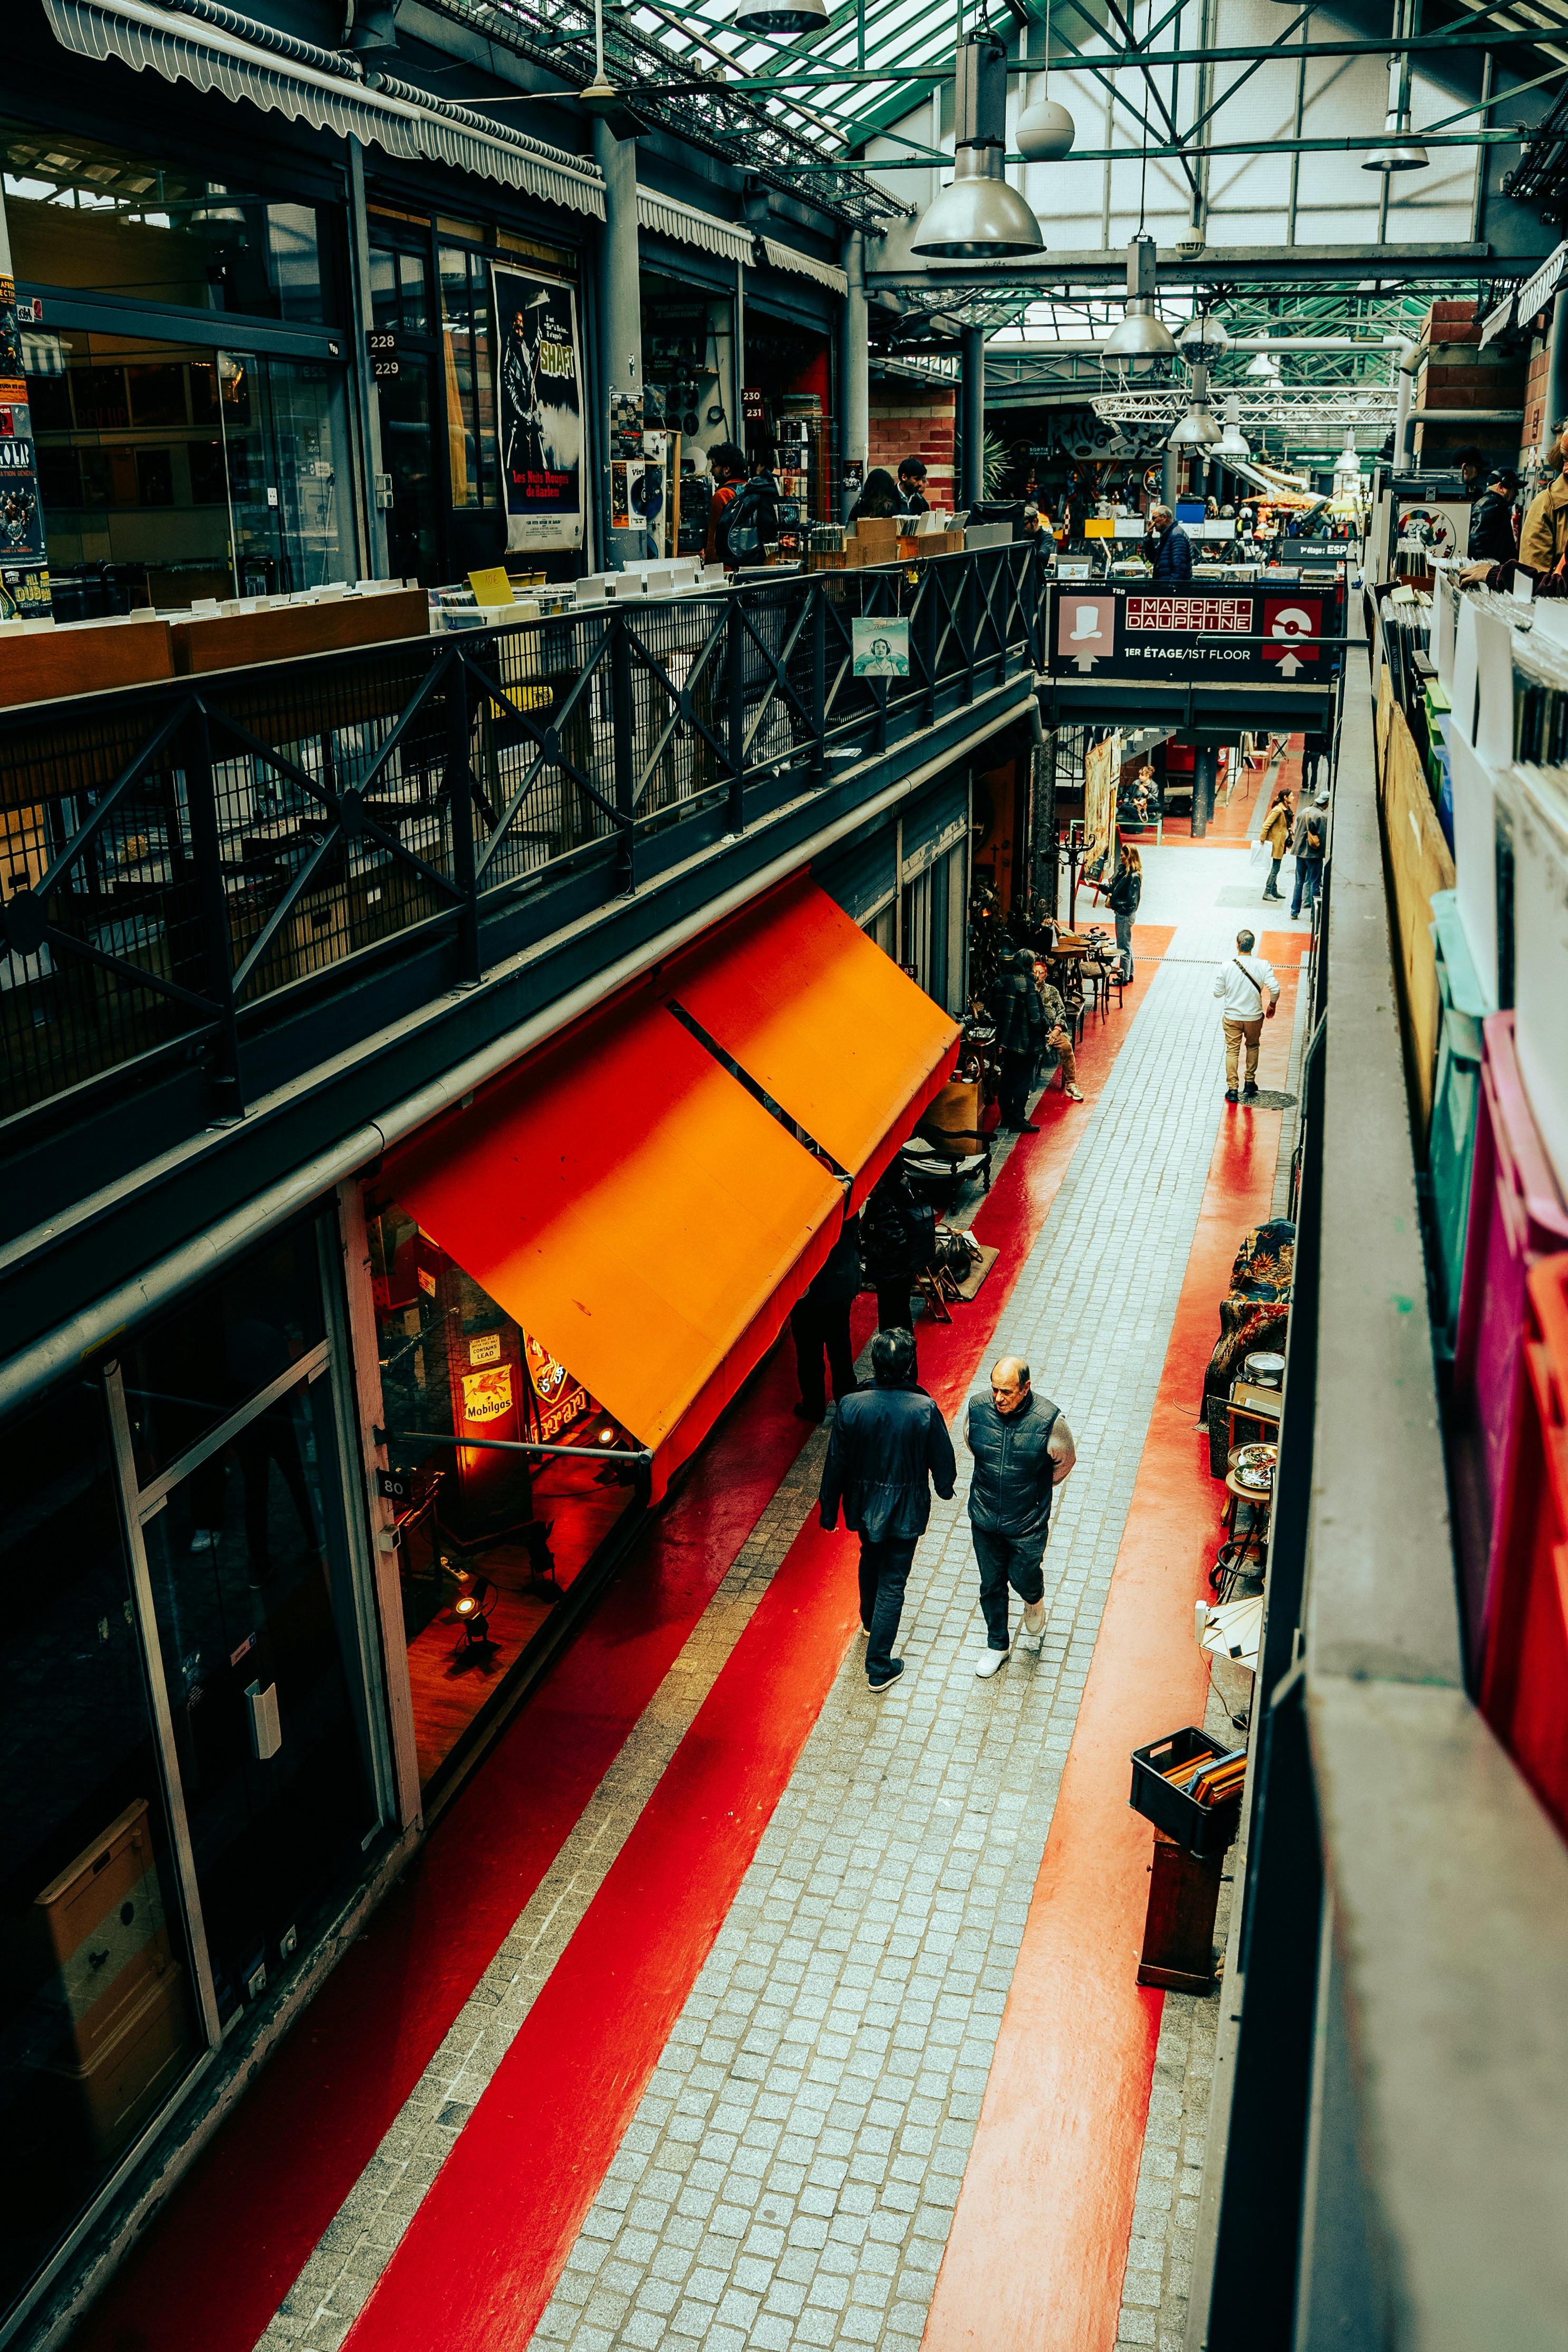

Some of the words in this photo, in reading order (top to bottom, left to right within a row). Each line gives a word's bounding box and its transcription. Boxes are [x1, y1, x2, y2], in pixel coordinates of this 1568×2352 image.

[371, 335, 395, 348] 228
[540, 340, 574, 379] SHAFT
[376, 362, 399, 375] 229
[743, 392, 760, 400] 230
[513, 470, 526, 483] Les
[527, 471, 543, 484] Nuits
[545, 471, 569, 486] Rouges
[526, 484, 534, 497] de
[535, 485, 560, 497] Harlem
[1326, 545, 1348, 555] ESP
[26, 573, 39, 586] ALL
[485, 574, 500, 587] 10€
[15, 585, 42, 602] DUB
[1144, 600, 1234, 613] MARCHÉ
[1129, 616, 1249, 629] DAUPHINE
[1124, 648, 1141, 657] 1ER
[1210, 649, 1250, 660] FLOOR
[473, 1344, 497, 1354] CONTAINS
[477, 1350, 494, 1359] LEAD
[468, 1399, 511, 1418] Mobilgas
[384, 1480, 403, 1495] 80
